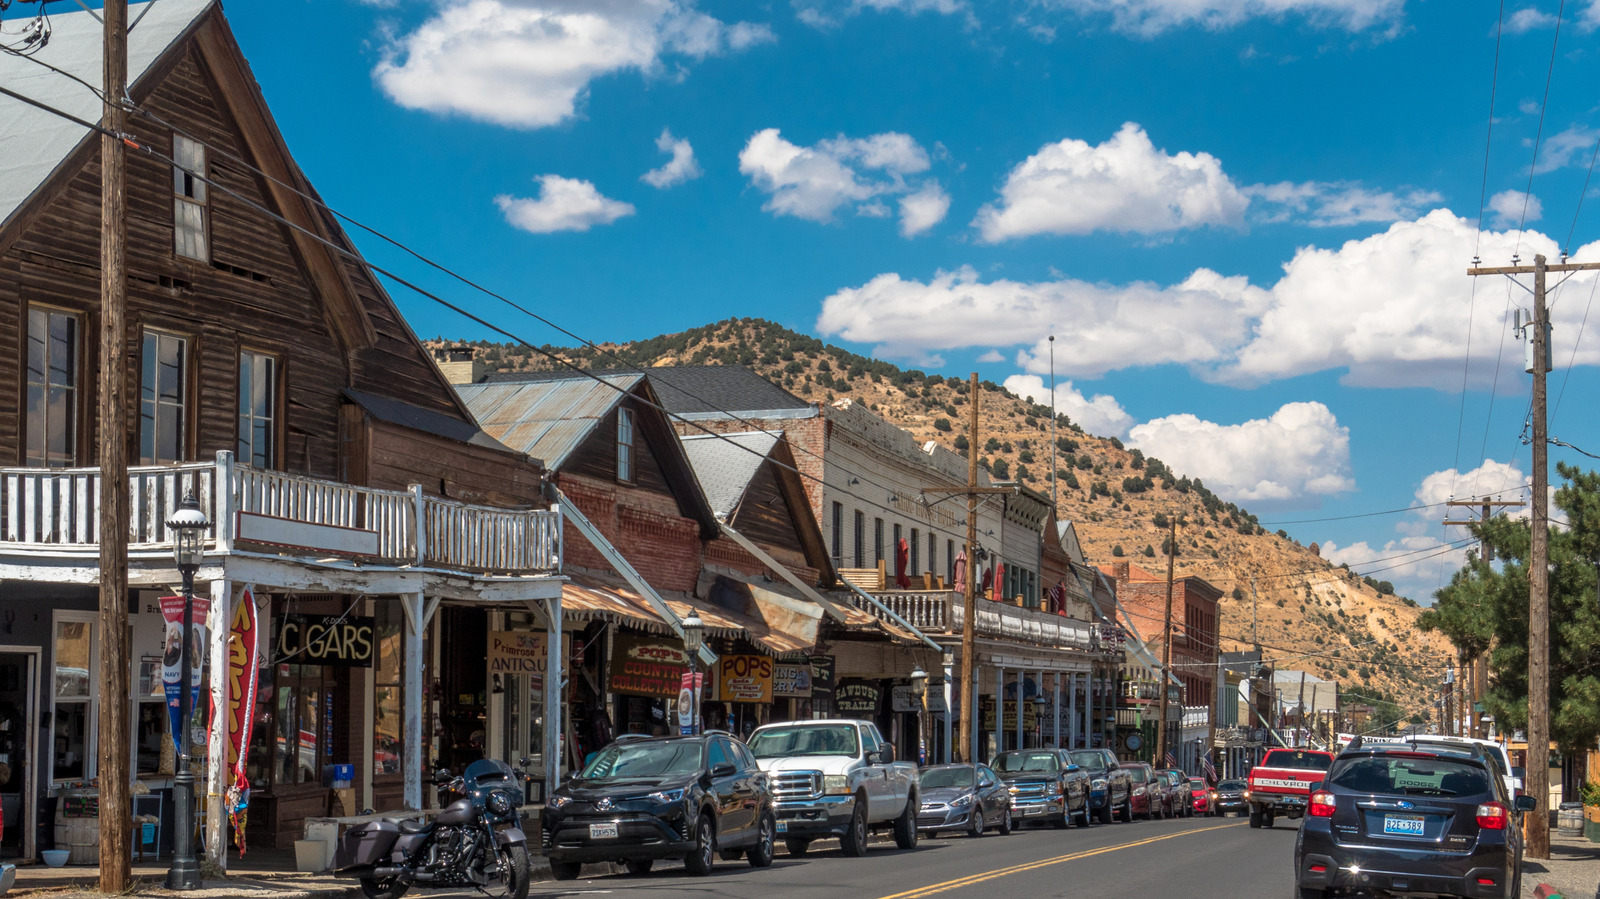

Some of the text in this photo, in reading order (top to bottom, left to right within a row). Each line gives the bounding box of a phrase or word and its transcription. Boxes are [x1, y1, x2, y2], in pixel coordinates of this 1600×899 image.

[494, 638, 535, 656] Primrose
[491, 657, 548, 672] ANTIQU
[723, 656, 771, 678] POPS
[775, 668, 798, 680] ING
[612, 675, 682, 695] COLLECTAB
[836, 684, 879, 701] SAWDUST
[839, 701, 875, 711] TRAILS
[1261, 779, 1310, 788] CHEVROL
